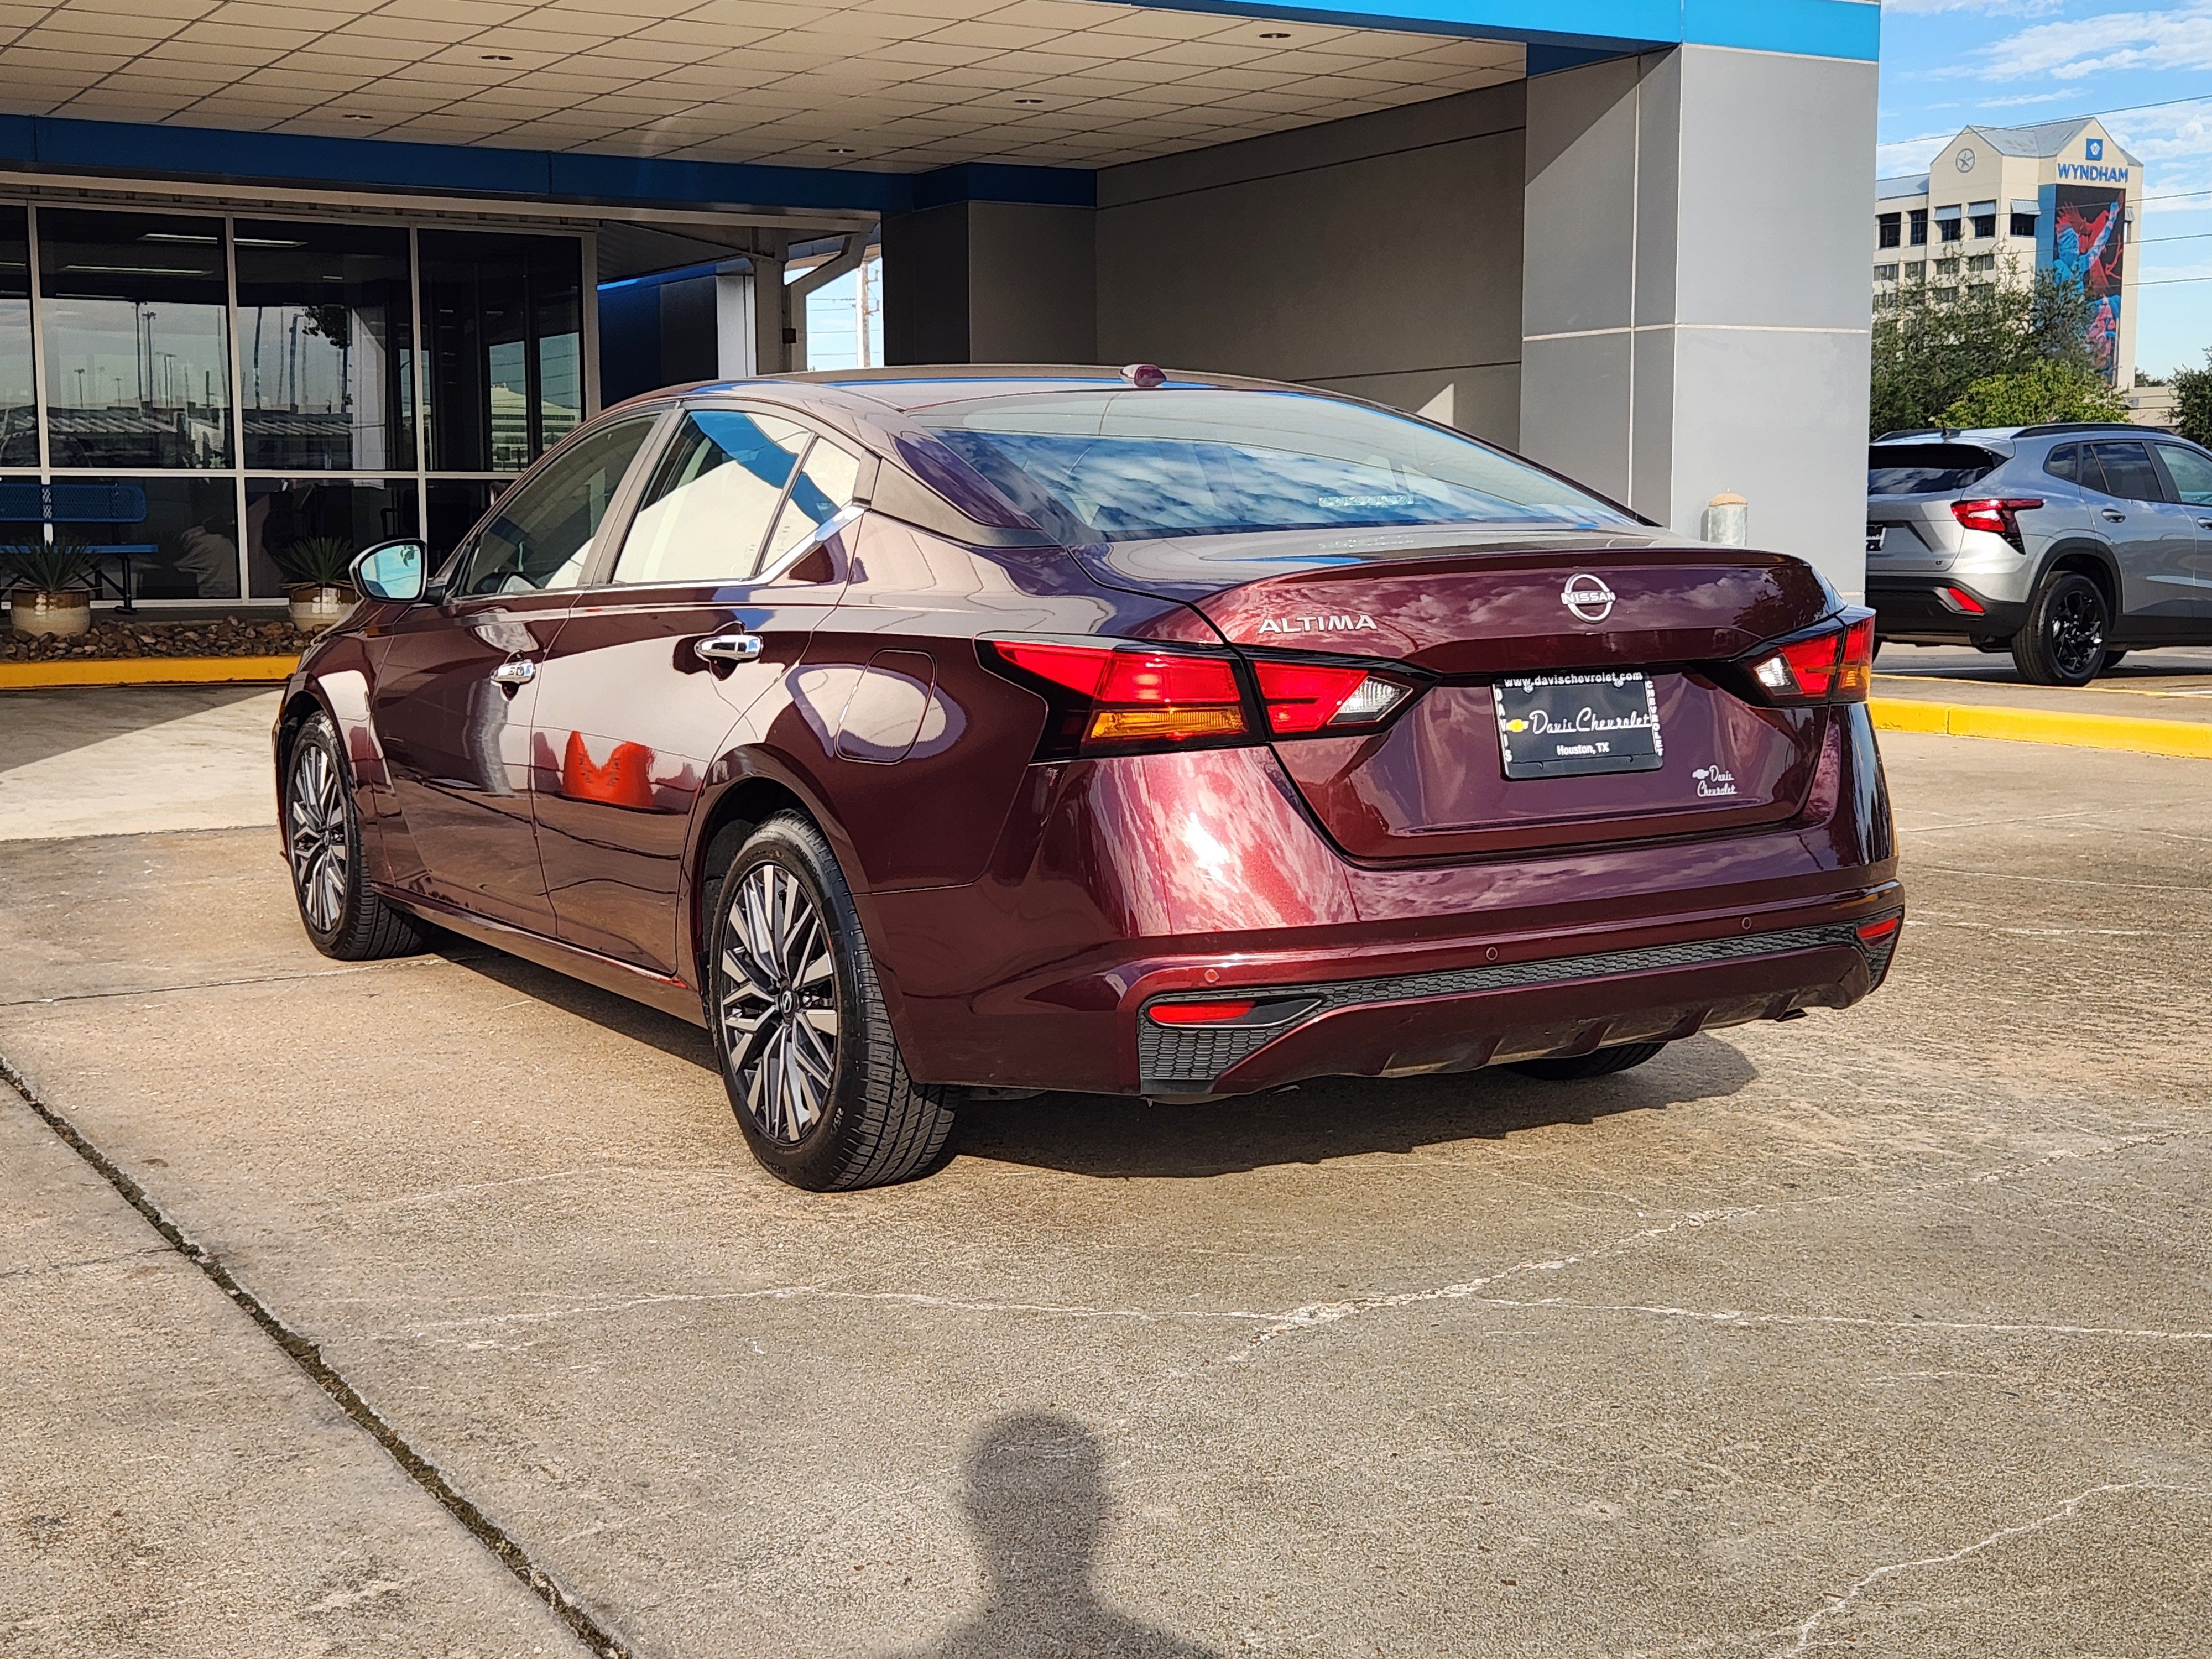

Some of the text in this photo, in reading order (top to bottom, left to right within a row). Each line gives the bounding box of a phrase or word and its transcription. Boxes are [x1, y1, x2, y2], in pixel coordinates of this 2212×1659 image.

[2058, 164, 2128, 183] WYNDHAM
[1562, 591, 1616, 604] NISSAN
[1258, 615, 1378, 634] ALTIMA
[1495, 688, 1512, 763] DAVIS
[1529, 707, 1653, 734] Davis Chevrolet
[1646, 680, 1664, 756] CHEVROLET
[1556, 742, 1610, 756] Houston, TX
